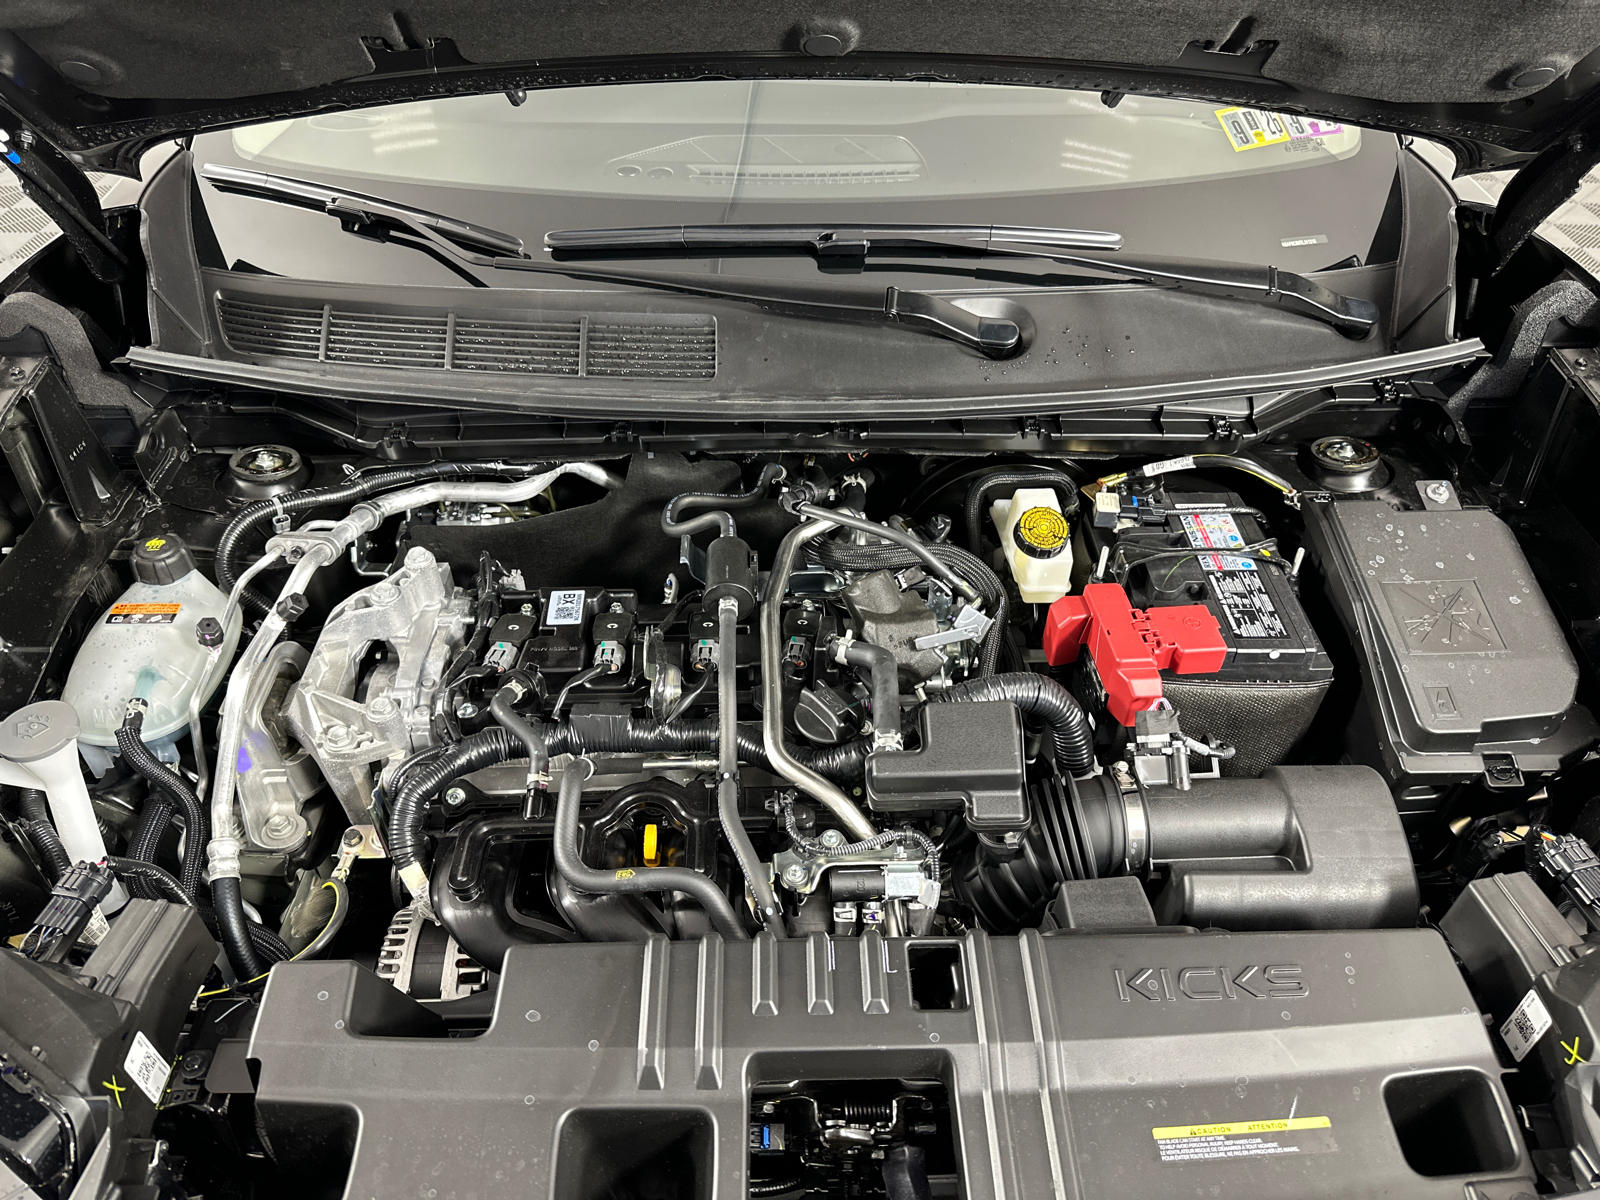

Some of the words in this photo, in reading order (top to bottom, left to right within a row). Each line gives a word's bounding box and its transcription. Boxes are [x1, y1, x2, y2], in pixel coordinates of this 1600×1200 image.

[1231, 120, 1250, 145] 9
[562, 593, 576, 606] BX
[1114, 963, 1310, 1002] KICKS
[1197, 1126, 1231, 1135] CAUTION
[1248, 1122, 1288, 1131] ATTENTION
